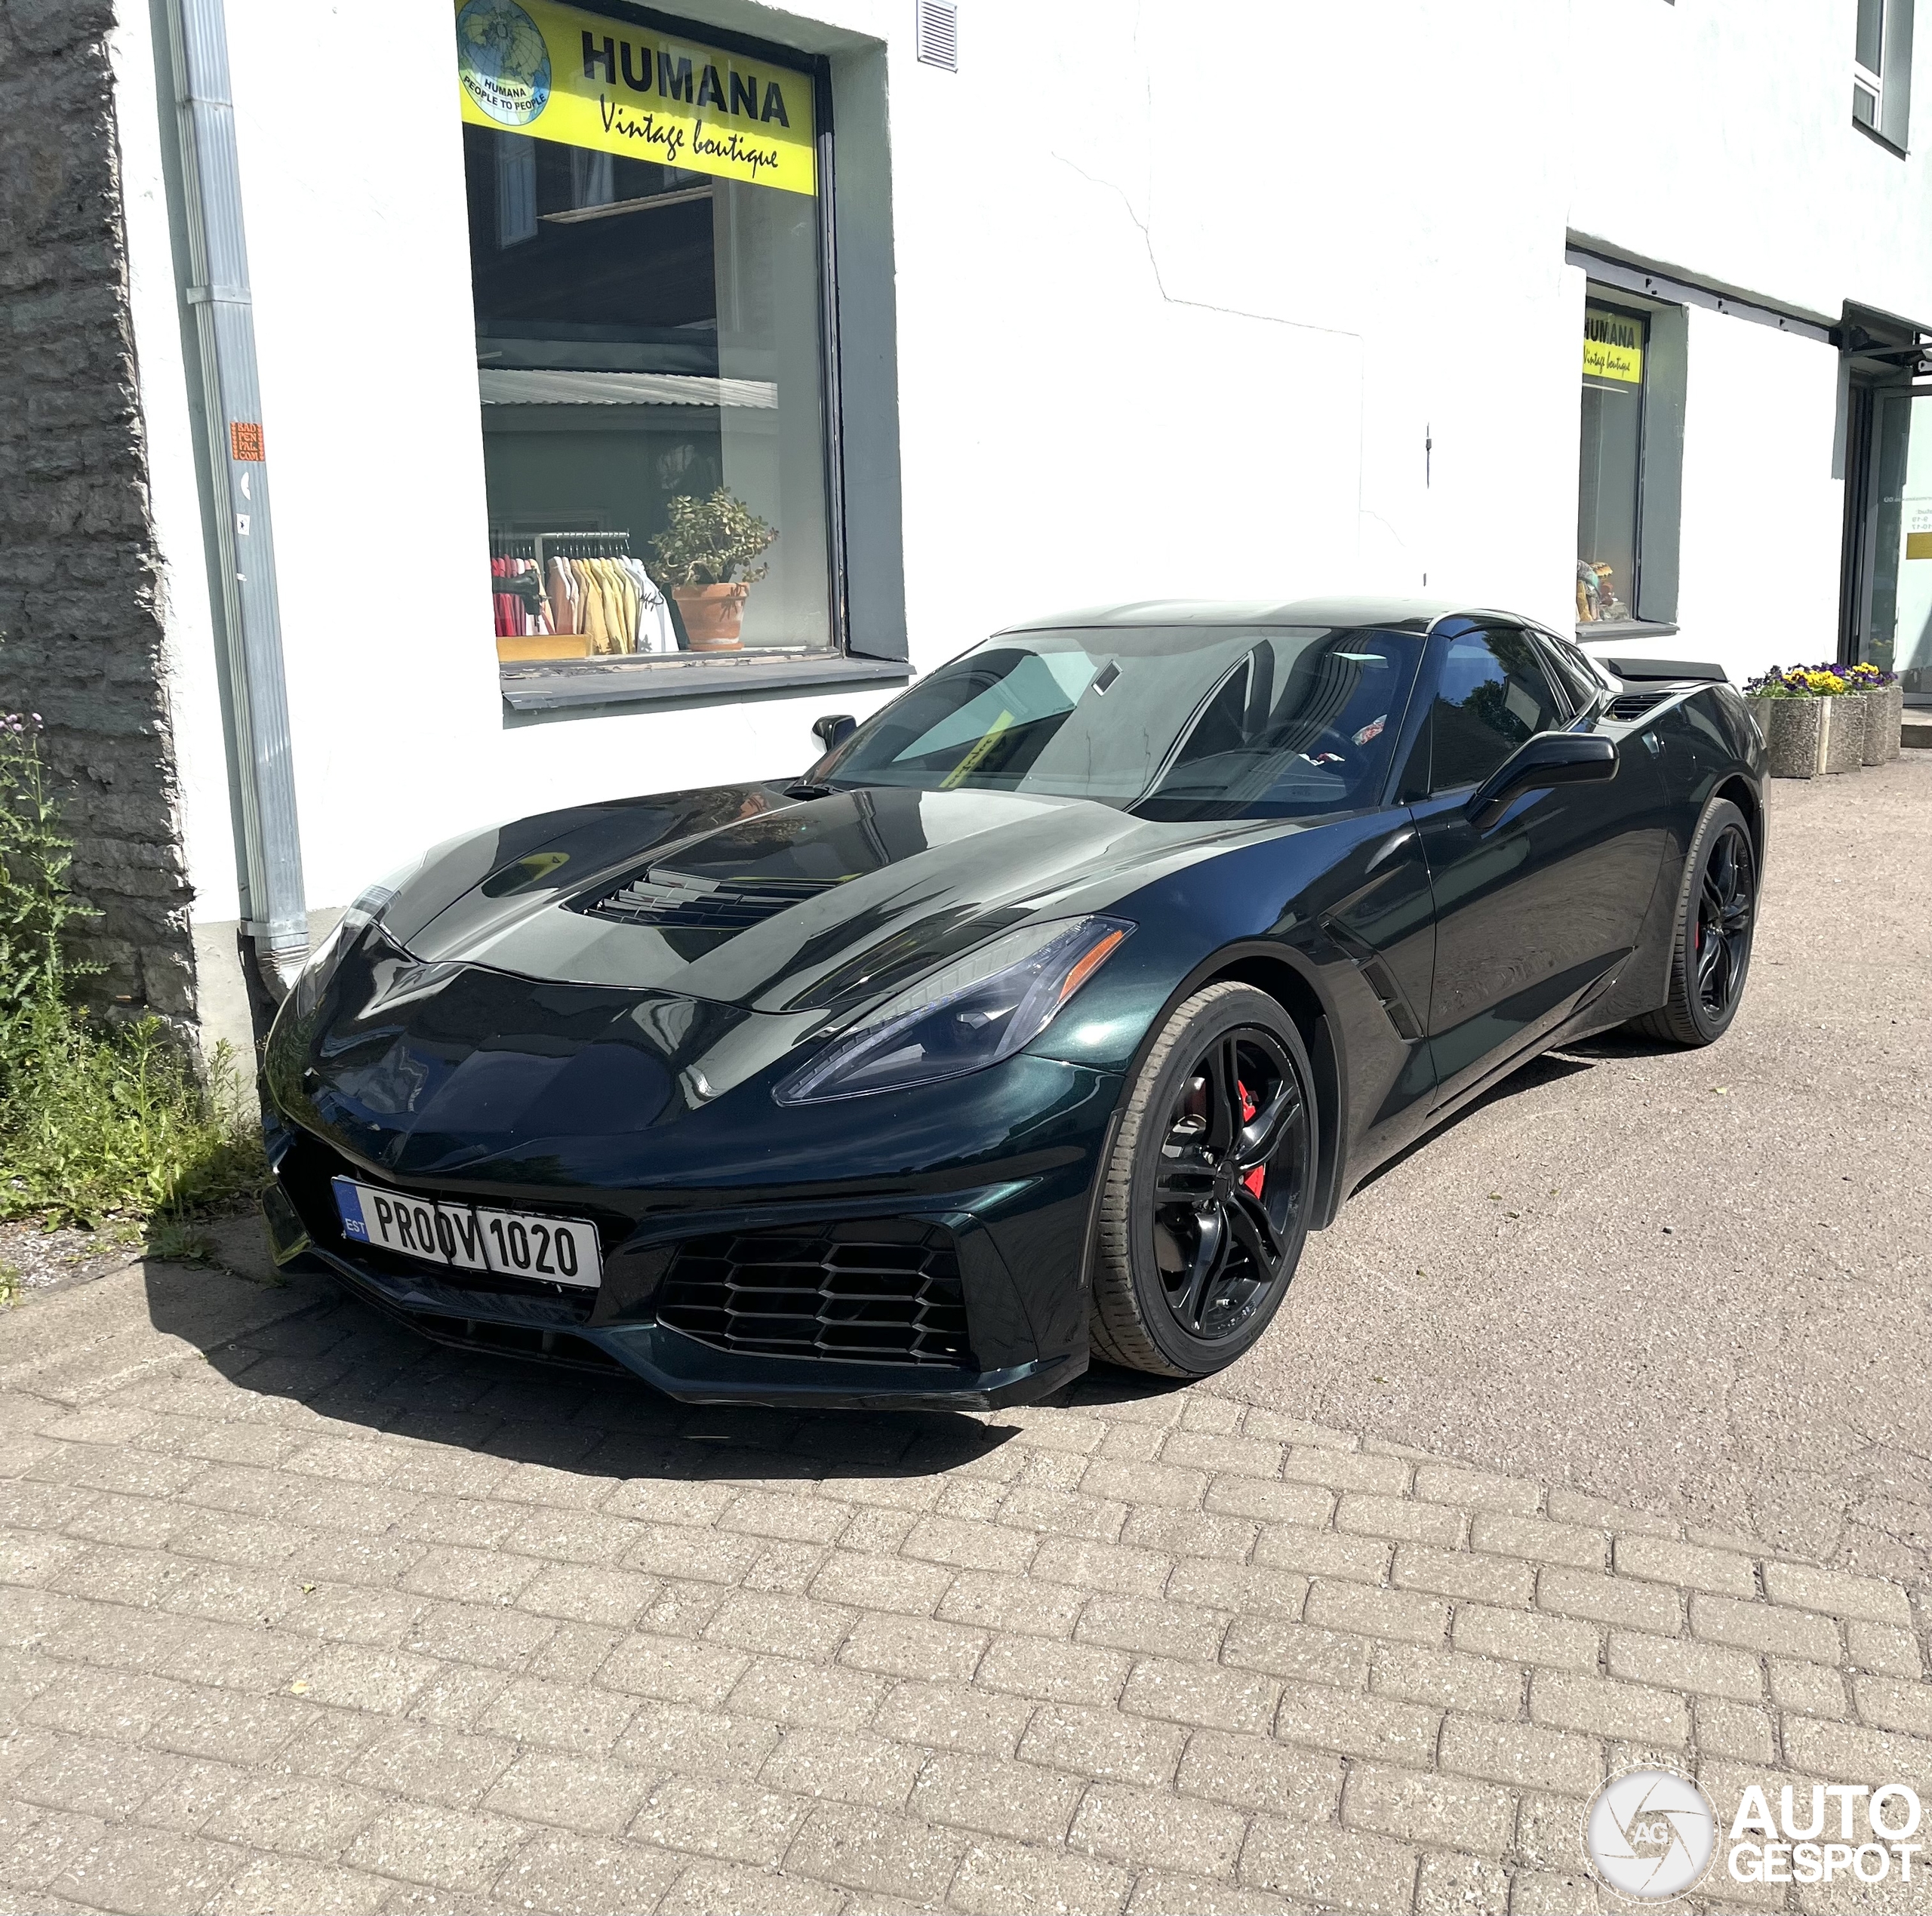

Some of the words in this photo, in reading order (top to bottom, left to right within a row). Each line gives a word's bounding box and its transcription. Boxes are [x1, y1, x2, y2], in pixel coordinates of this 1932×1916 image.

[463, 75, 498, 106] PEOPLE
[500, 99, 512, 109] TO
[515, 93, 546, 110] PEOPLE
[485, 78, 527, 98] HUMANA
[582, 30, 790, 128] HUMANA
[600, 94, 685, 161] Vintage
[693, 118, 778, 179] boutique
[1584, 318, 1635, 349] HUMANA
[238, 423, 257, 432] BAD
[238, 432, 257, 442] PEN
[344, 1217, 365, 1235] EST
[490, 1218, 578, 1277] 1020
